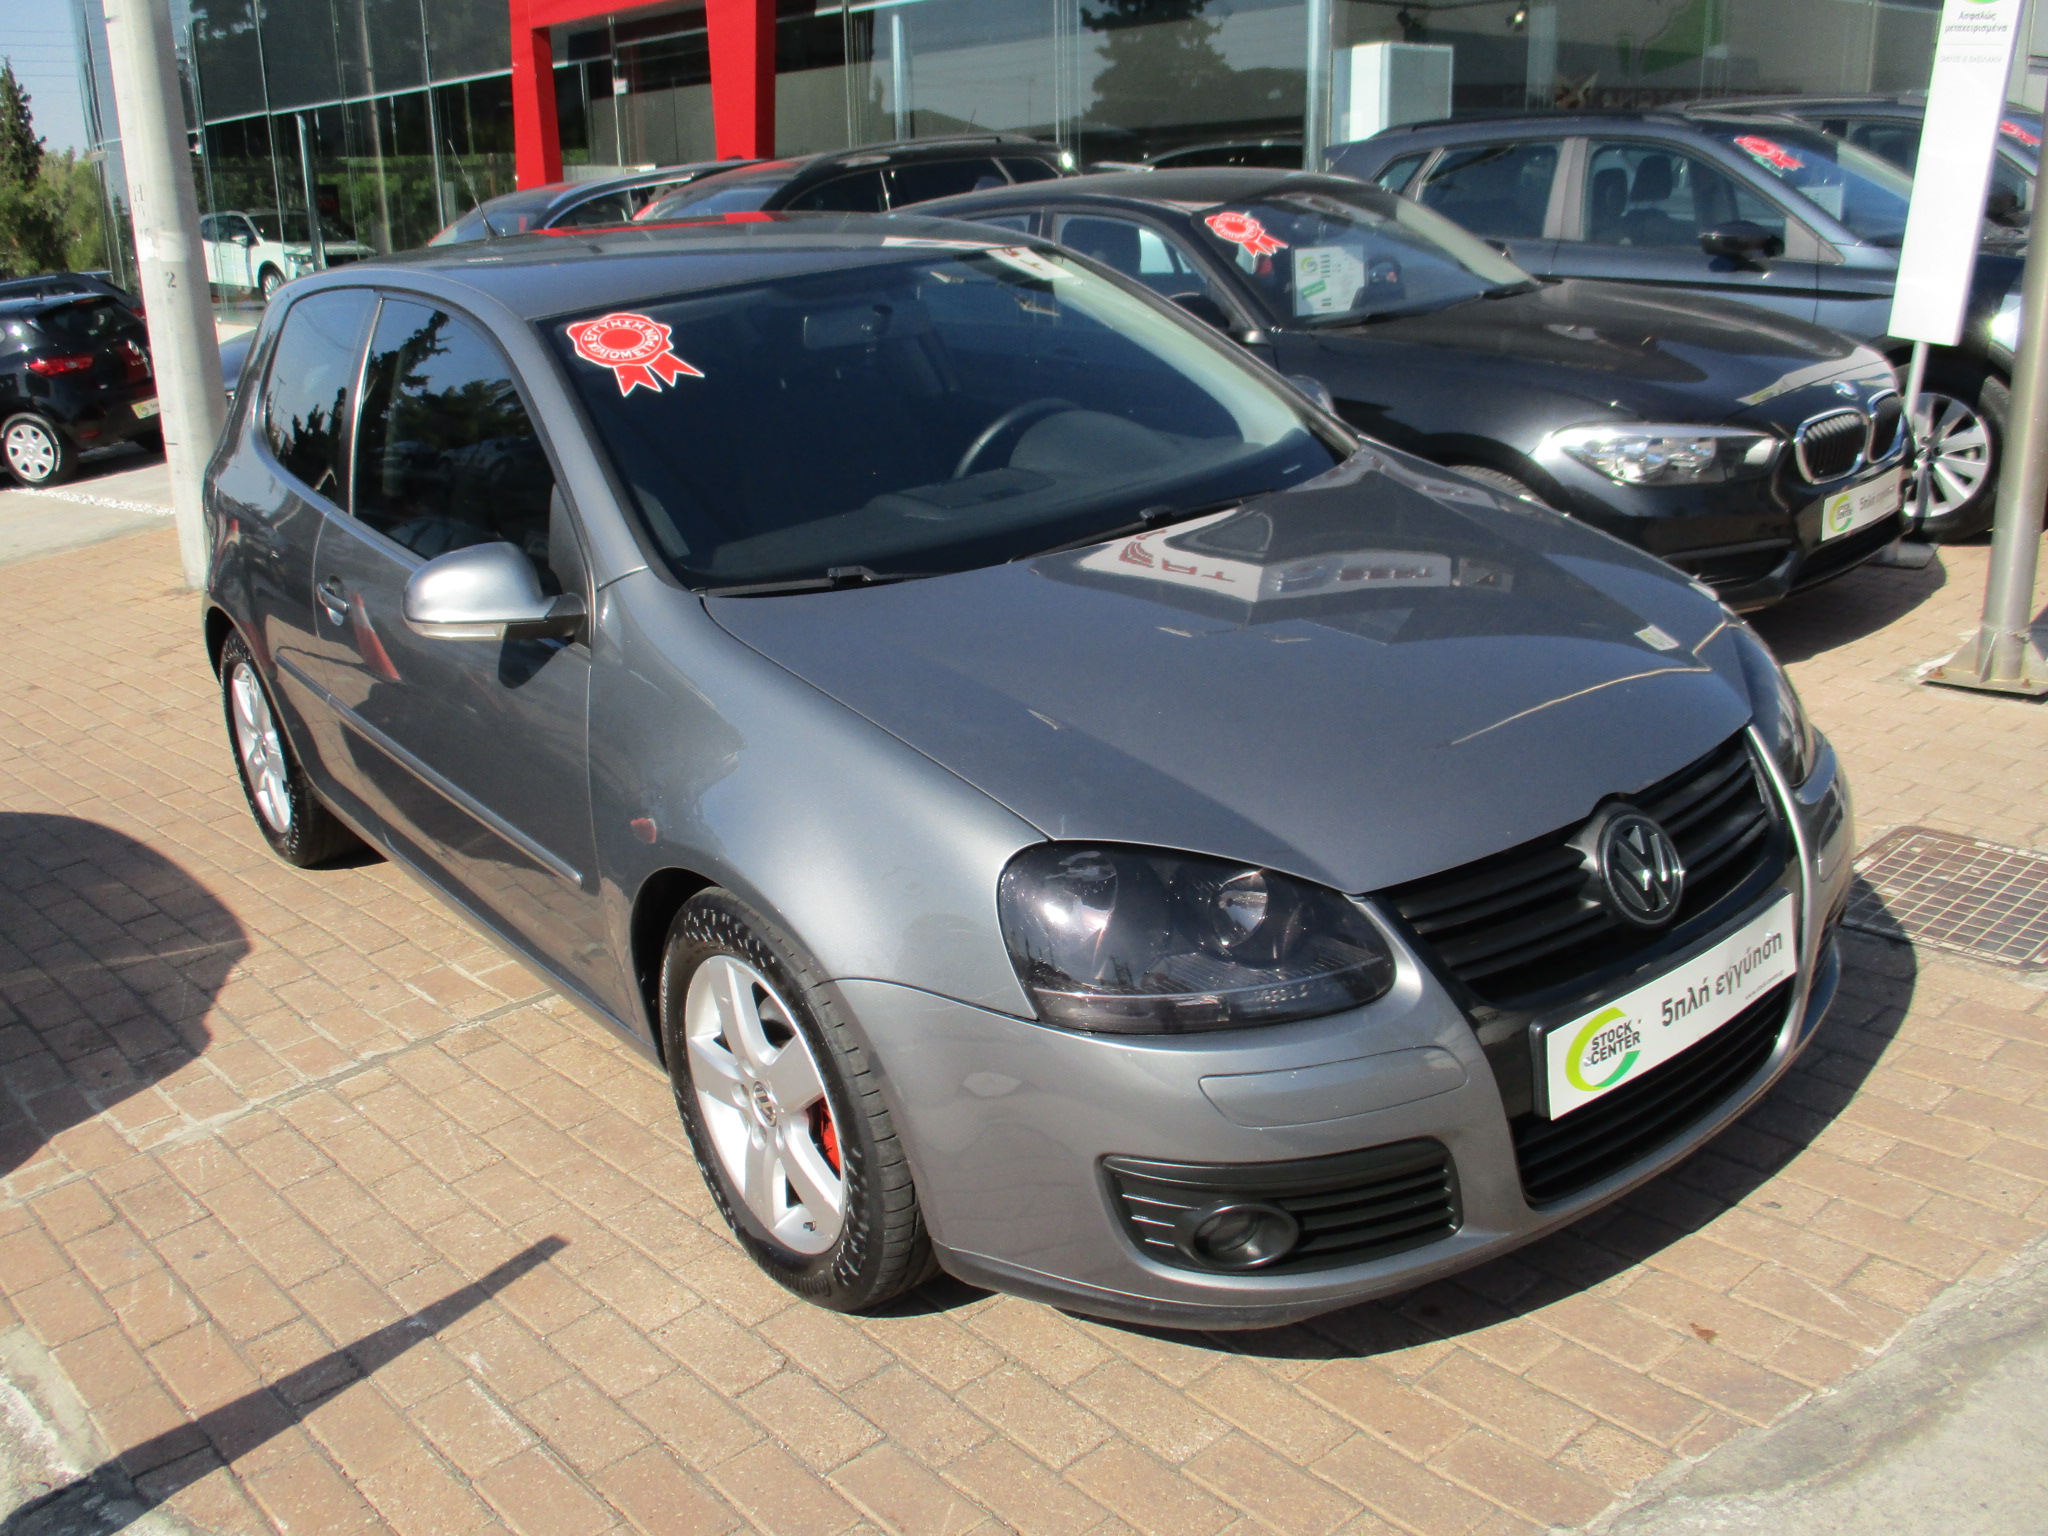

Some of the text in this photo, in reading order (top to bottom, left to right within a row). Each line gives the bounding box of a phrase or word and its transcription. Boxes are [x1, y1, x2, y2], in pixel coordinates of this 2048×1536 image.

[1660, 977, 1710, 1027] 5πλή
[1590, 1031, 1641, 1066] CENTER
[1591, 1020, 1633, 1051] STOCK
